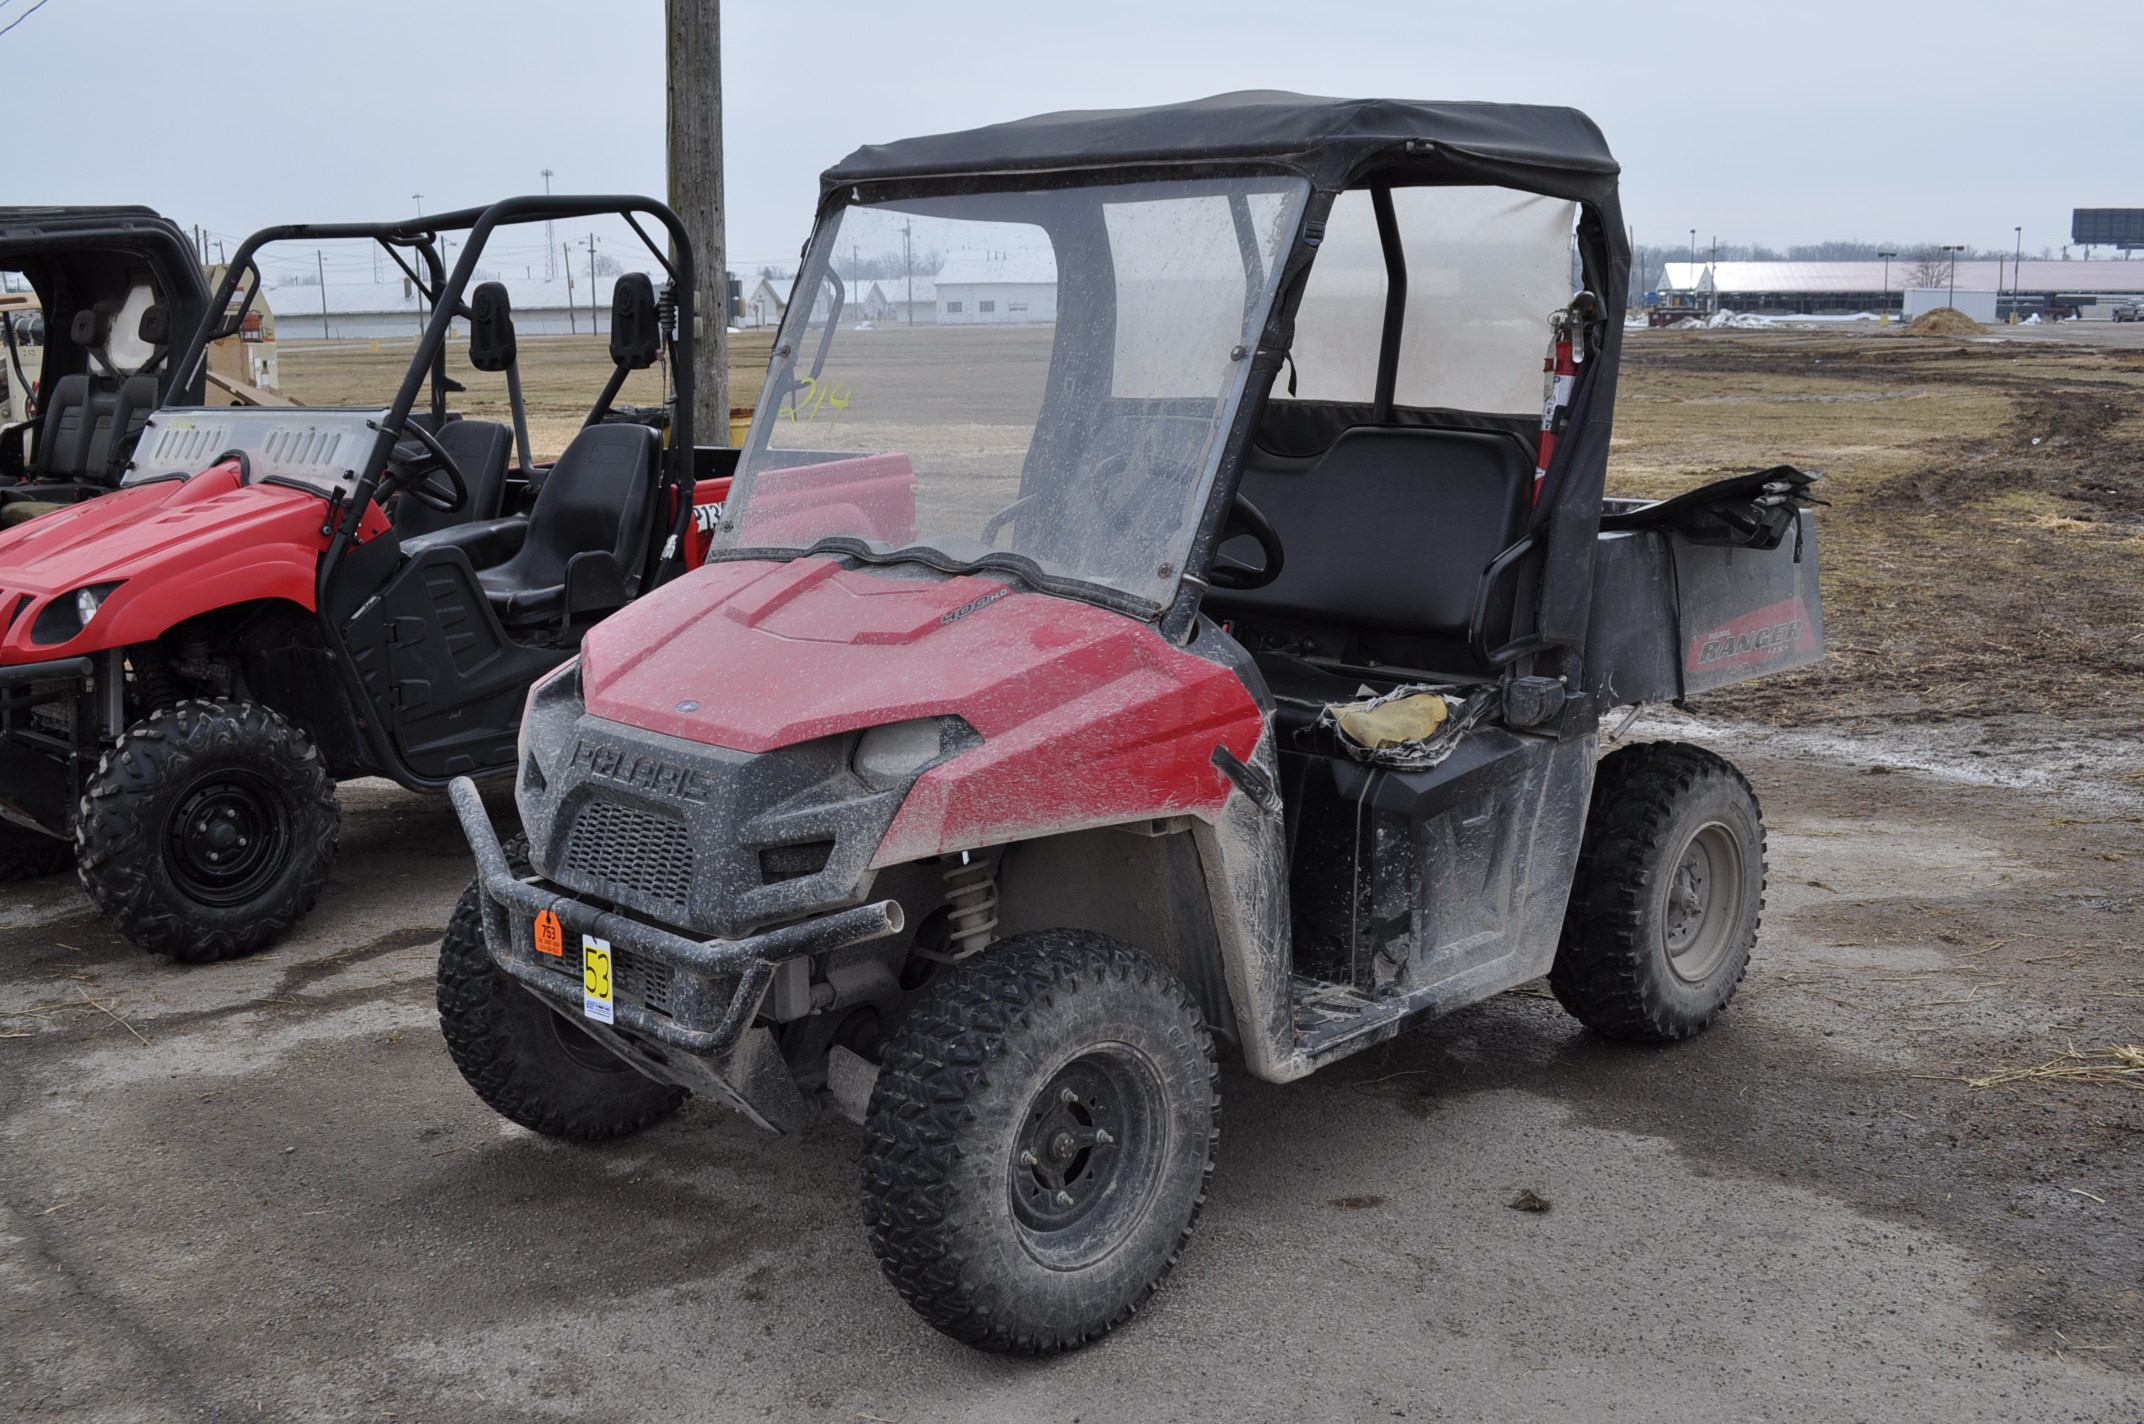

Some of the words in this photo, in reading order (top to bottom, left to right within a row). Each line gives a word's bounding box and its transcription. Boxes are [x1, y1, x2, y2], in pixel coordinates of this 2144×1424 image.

[778, 377, 855, 431] 214
[941, 594, 991, 624] 400
[1698, 620, 1803, 664] RANGER
[570, 740, 717, 805] POLARIS
[541, 924, 556, 940] 753
[585, 947, 609, 998] 53
